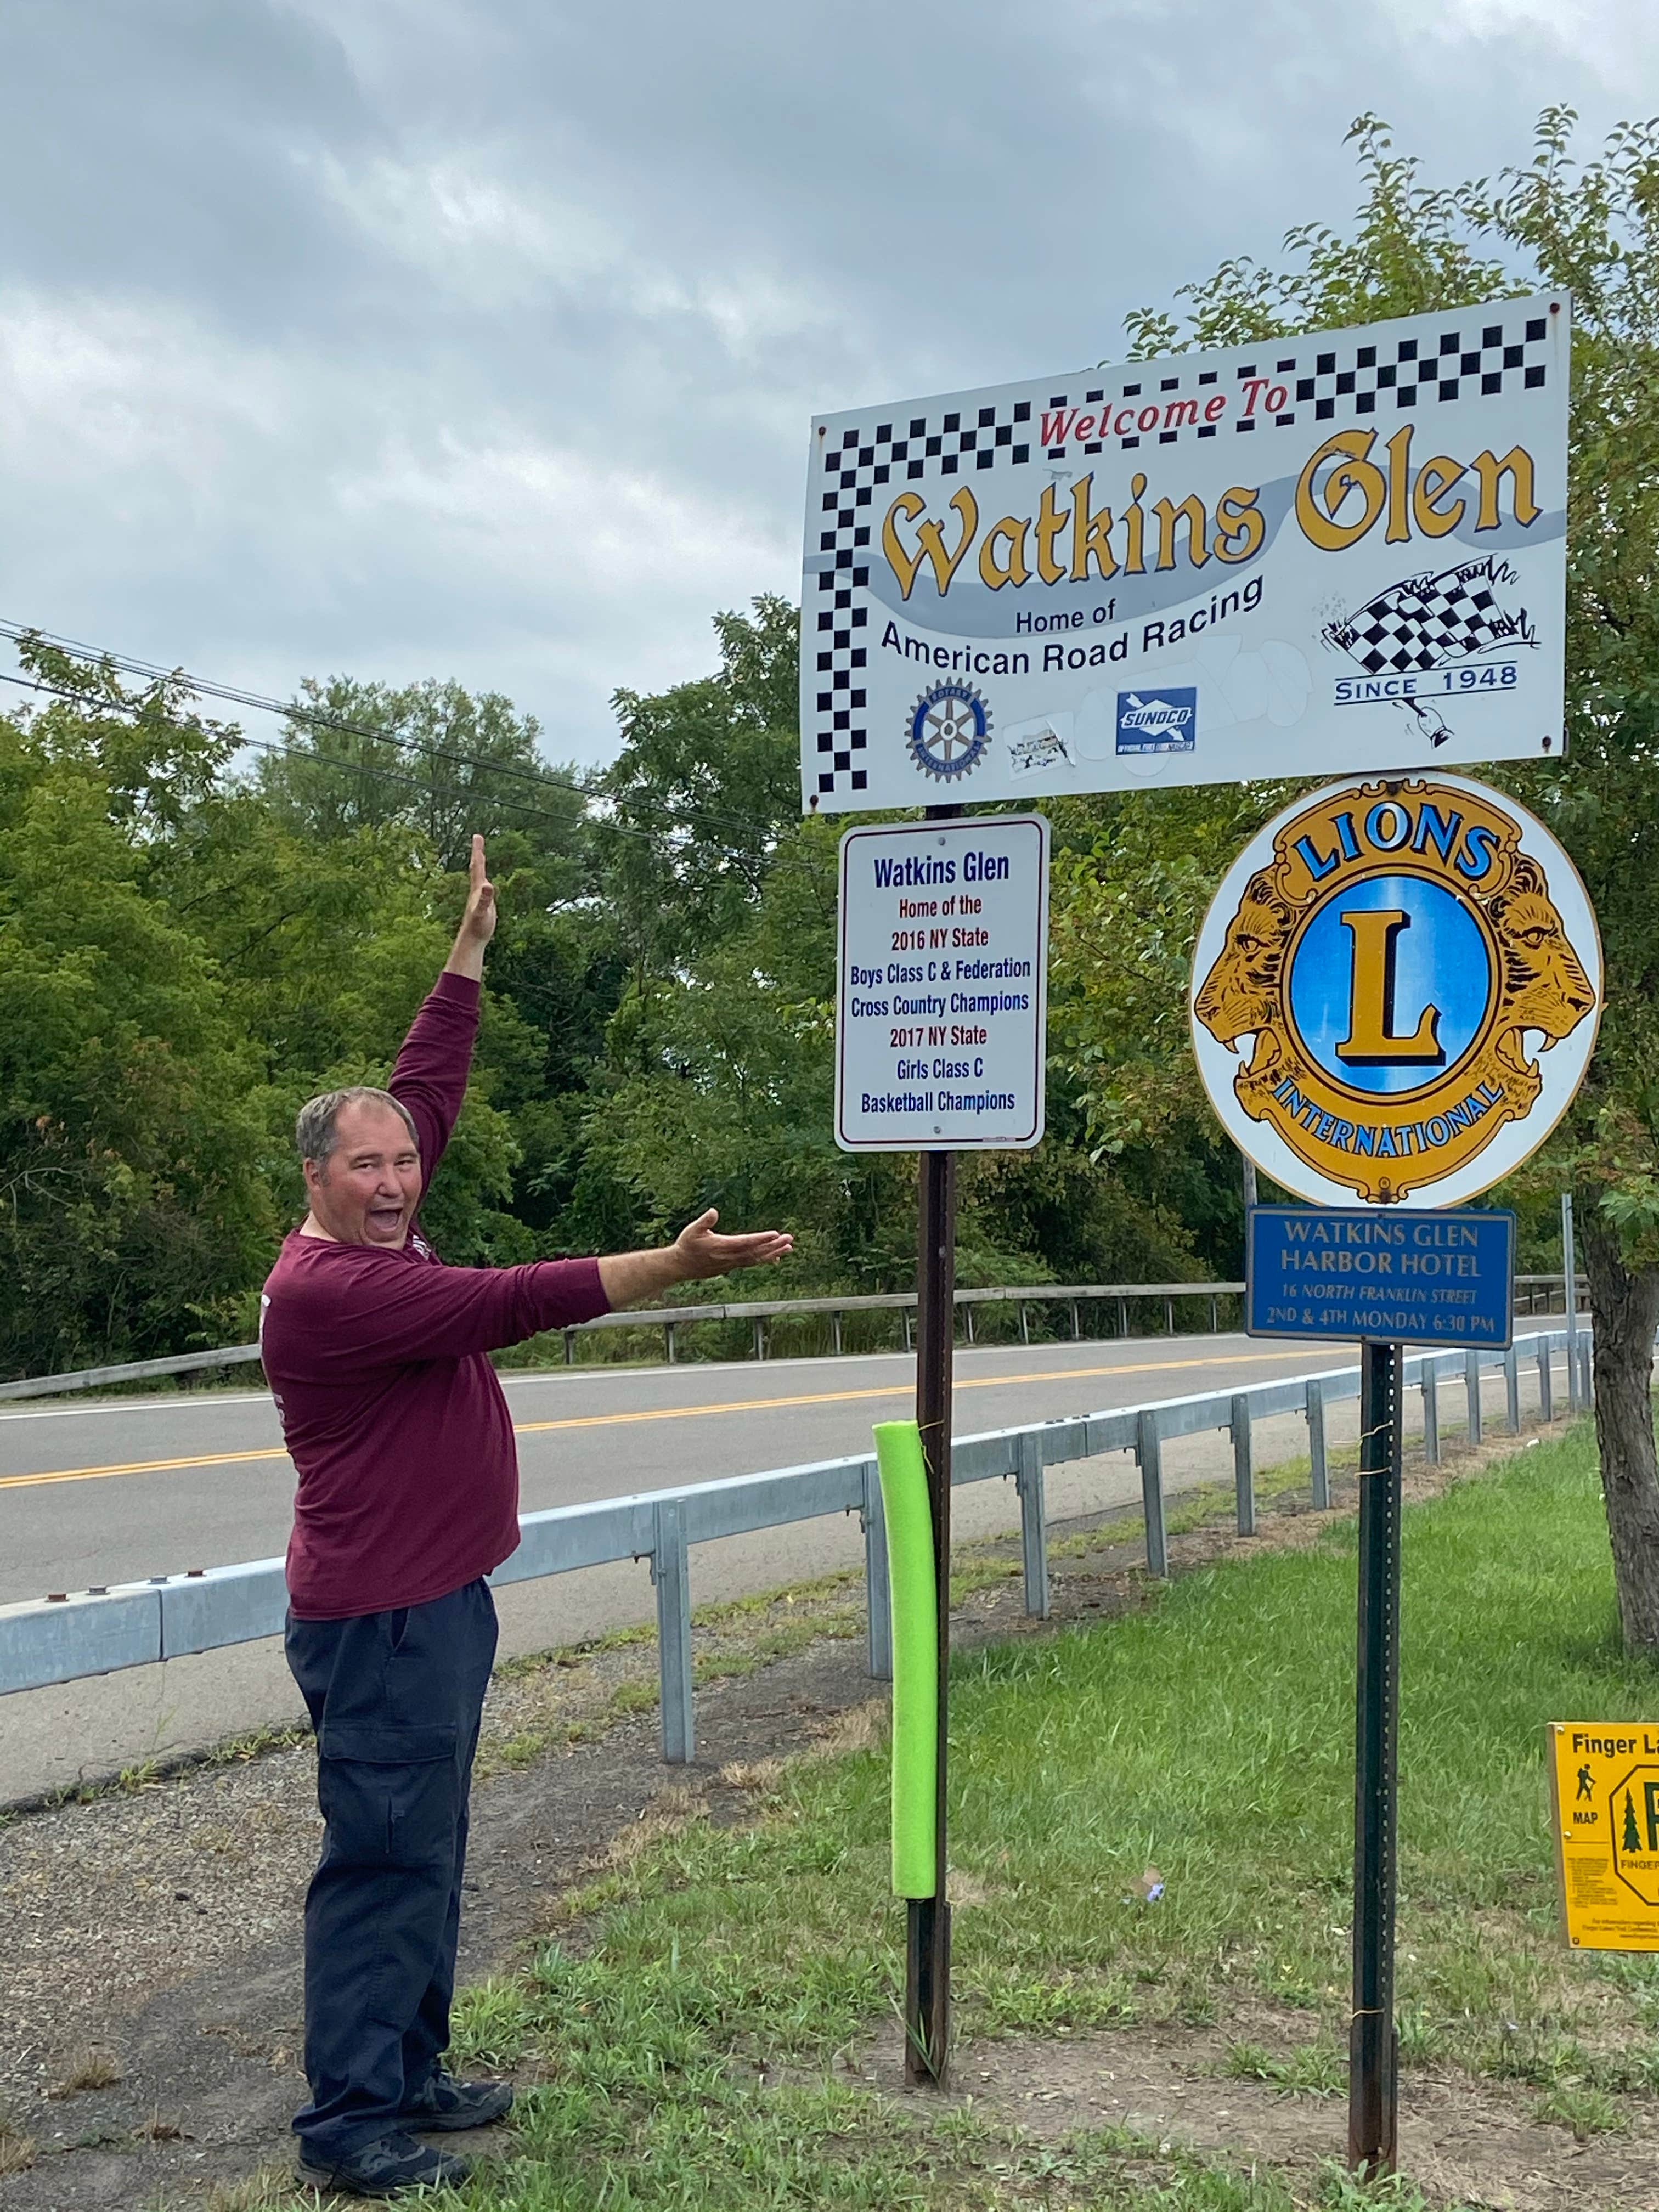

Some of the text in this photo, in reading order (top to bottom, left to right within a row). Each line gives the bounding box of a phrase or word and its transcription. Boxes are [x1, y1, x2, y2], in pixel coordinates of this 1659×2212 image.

[1040, 379, 1288, 447] Welcome To
[882, 424, 1543, 601] Watkins Glen
[881, 574, 1263, 675] American Road Racing
[1015, 597, 1116, 633] Home of
[931, 687, 968, 701] ROTARY
[1335, 665, 1517, 701] SINCE 1948
[1124, 709, 1189, 726] SUNOCO
[1293, 801, 1500, 881] LIONS
[874, 851, 1009, 888] Watkins Glen
[899, 895, 982, 918] Home of the
[891, 927, 989, 951] 2016 NY State
[850, 957, 1031, 989] Boys Class C & Federation
[1335, 909, 1446, 1067] L
[851, 991, 1029, 1018] Cross Country Champions
[890, 1025, 988, 1047] 2017 NY State
[897, 1057, 983, 1080] Girls Class C
[861, 1090, 1015, 1114] Basketball Champions
[1271, 1077, 1503, 1157] INTERNATIONAL
[1284, 1221, 1479, 1248] WATKINS GLEN
[1280, 1249, 1481, 1277] HARBOR HOTEL
[1283, 1283, 1477, 1304] 16 NORTH FRANKLIN STREET
[1266, 1307, 1494, 1333] 2ND & 4TH MONDAY 6:30 PM
[1572, 1733, 1637, 1758] Finger
[1573, 1812, 1598, 1824] MAP
